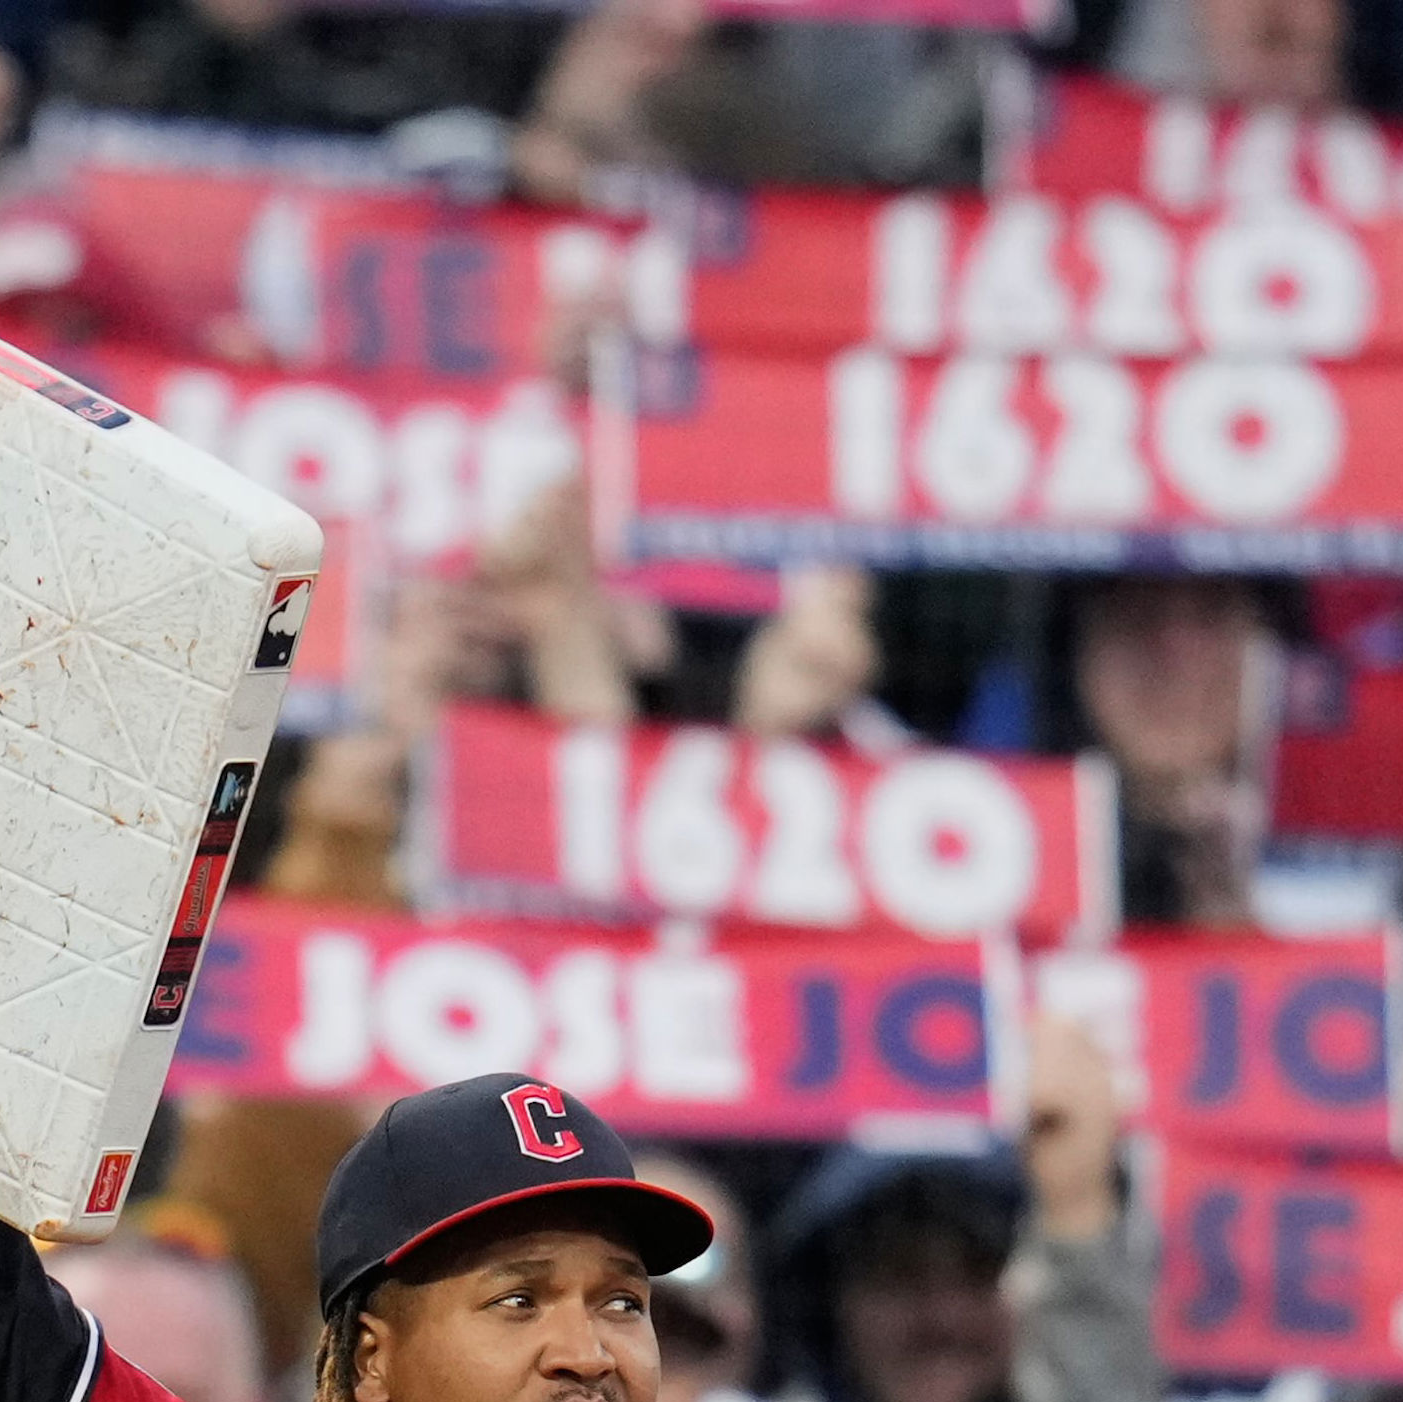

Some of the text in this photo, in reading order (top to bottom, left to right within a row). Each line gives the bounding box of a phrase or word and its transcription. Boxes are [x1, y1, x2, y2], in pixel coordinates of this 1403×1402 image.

[346, 249, 496, 373] SE
[874, 194, 1377, 356] 1620
[830, 346, 1343, 522] 1620
[558, 729, 1039, 939] 1620
[289, 920, 751, 1103] JOSÉ
[792, 974, 987, 1091] JO
[1187, 974, 1386, 1107] JO
[502, 1083, 584, 1165] C
[1183, 1184, 1357, 1337] SE
